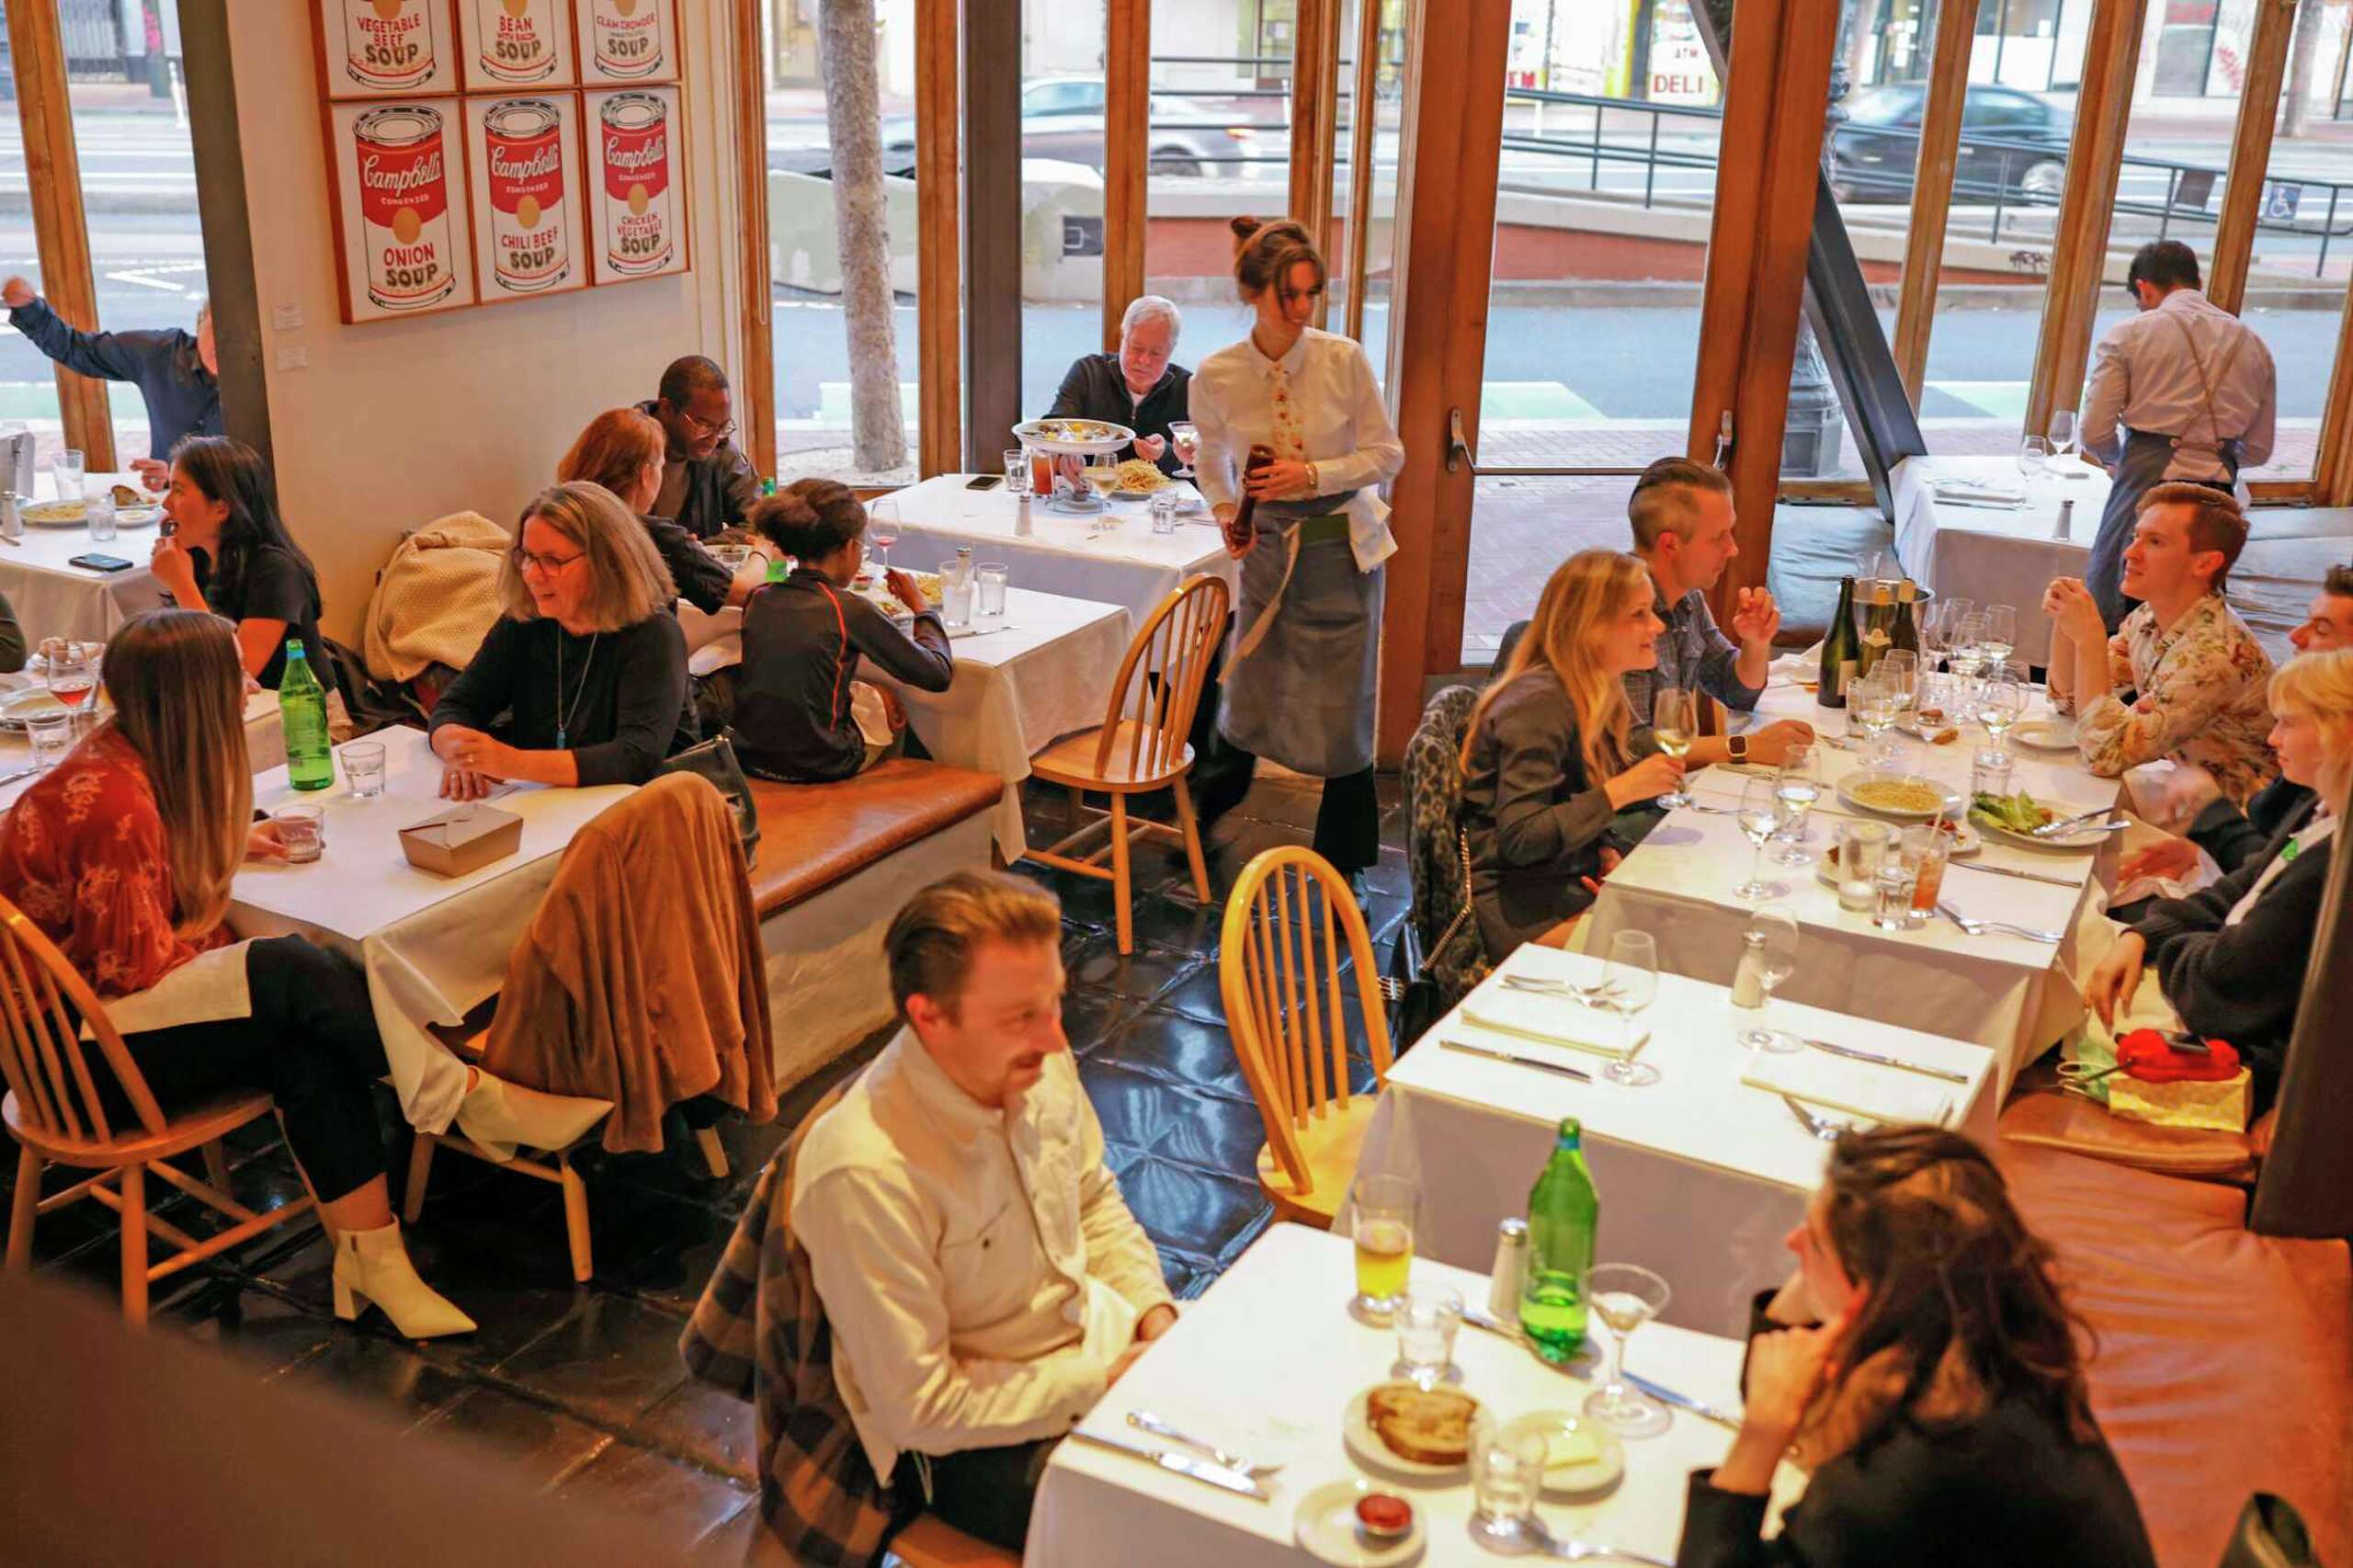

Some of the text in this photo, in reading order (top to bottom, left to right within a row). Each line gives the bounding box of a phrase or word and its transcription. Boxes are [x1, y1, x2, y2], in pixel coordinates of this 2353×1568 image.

[357, 13, 420, 33] VEGETABLE
[499, 15, 533, 31] BEAN
[597, 16, 619, 28] CLAM
[373, 33, 404, 46] BEEF
[608, 37, 648, 56] SOUP
[366, 43, 419, 66] SOUP
[496, 40, 541, 61] SOUP
[1506, 72, 1535, 88] TM
[1654, 74, 1703, 94] DELI
[501, 225, 559, 250] CHILI BEEF
[620, 233, 661, 254] SOUP
[383, 242, 435, 267] ONION
[509, 245, 555, 270] SOUP
[386, 261, 438, 288] SOUP
